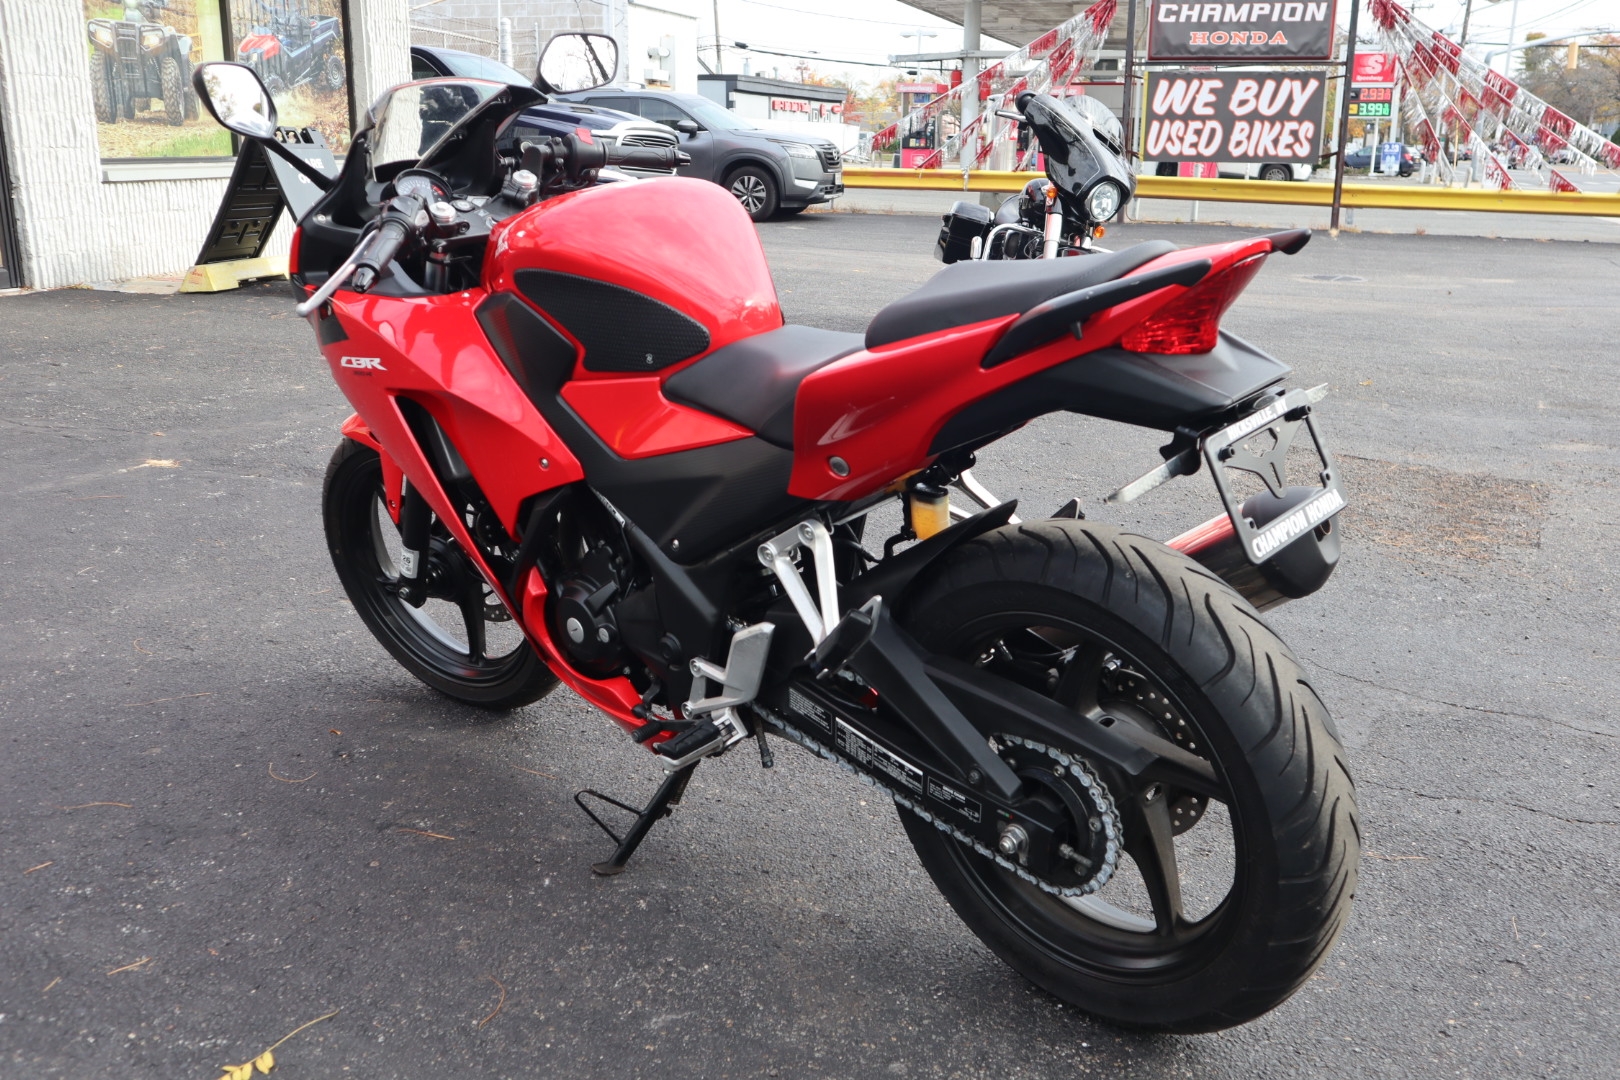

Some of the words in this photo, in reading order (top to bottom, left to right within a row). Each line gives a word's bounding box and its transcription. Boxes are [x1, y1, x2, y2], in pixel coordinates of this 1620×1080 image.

[1157, 2, 1328, 23] CHAMPION
[1189, 31, 1288, 45] HONDA
[1152, 78, 1224, 116] WE
[1228, 78, 1320, 117] BUY
[1146, 119, 1224, 157] USED
[1228, 120, 1315, 158] BIKES
[340, 356, 388, 371] CBR
[1252, 509, 1308, 558] CHAMPION
[1307, 488, 1344, 526] HONDA
